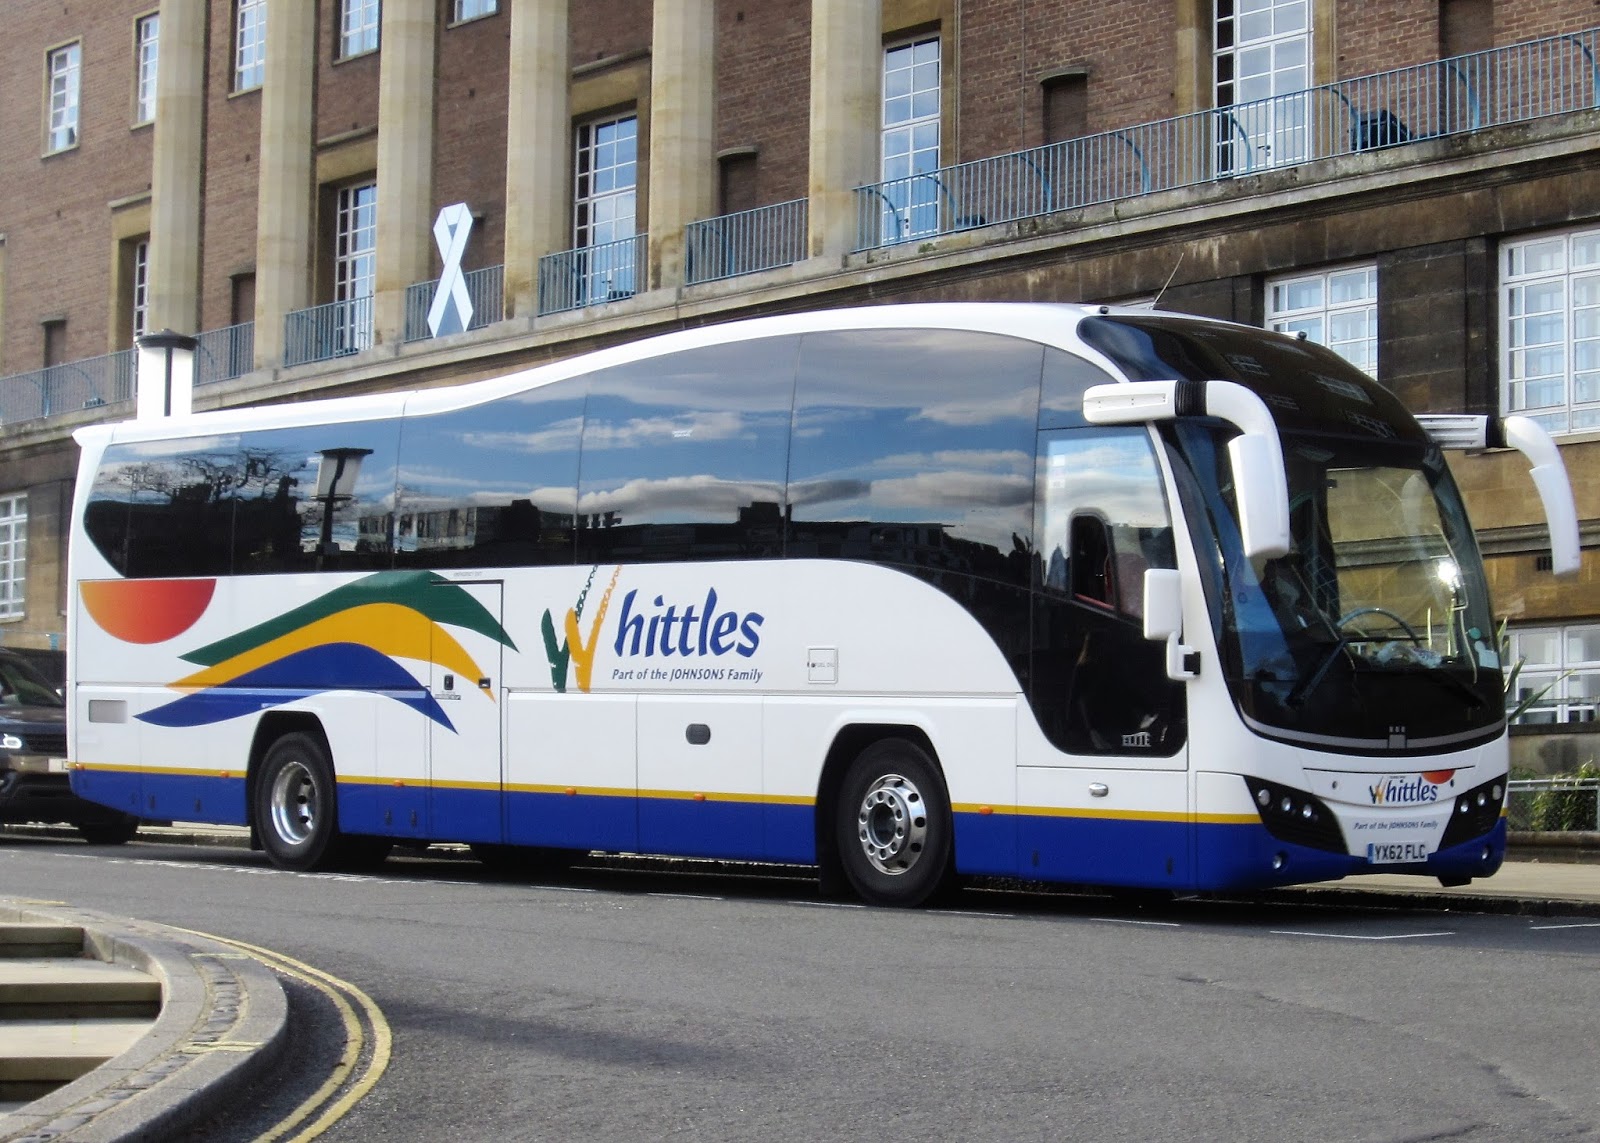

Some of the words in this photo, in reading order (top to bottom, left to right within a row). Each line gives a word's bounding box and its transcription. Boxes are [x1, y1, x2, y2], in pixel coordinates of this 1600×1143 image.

[541, 564, 765, 693] Whittles
[612, 669, 633, 680] Part
[636, 668, 649, 680] of
[650, 668, 667, 680] the
[669, 669, 725, 682] JOHNSONS
[727, 669, 763, 683] Family
[1369, 776, 1438, 805] Whittles
[1354, 822, 1368, 830] Part
[1369, 822, 1377, 830] of
[1377, 821, 1388, 830] the
[1388, 821, 1419, 831] JOHNSONS
[1420, 821, 1438, 829] Family
[1375, 845, 1403, 860] YX62
[1405, 844, 1426, 859] FLC
